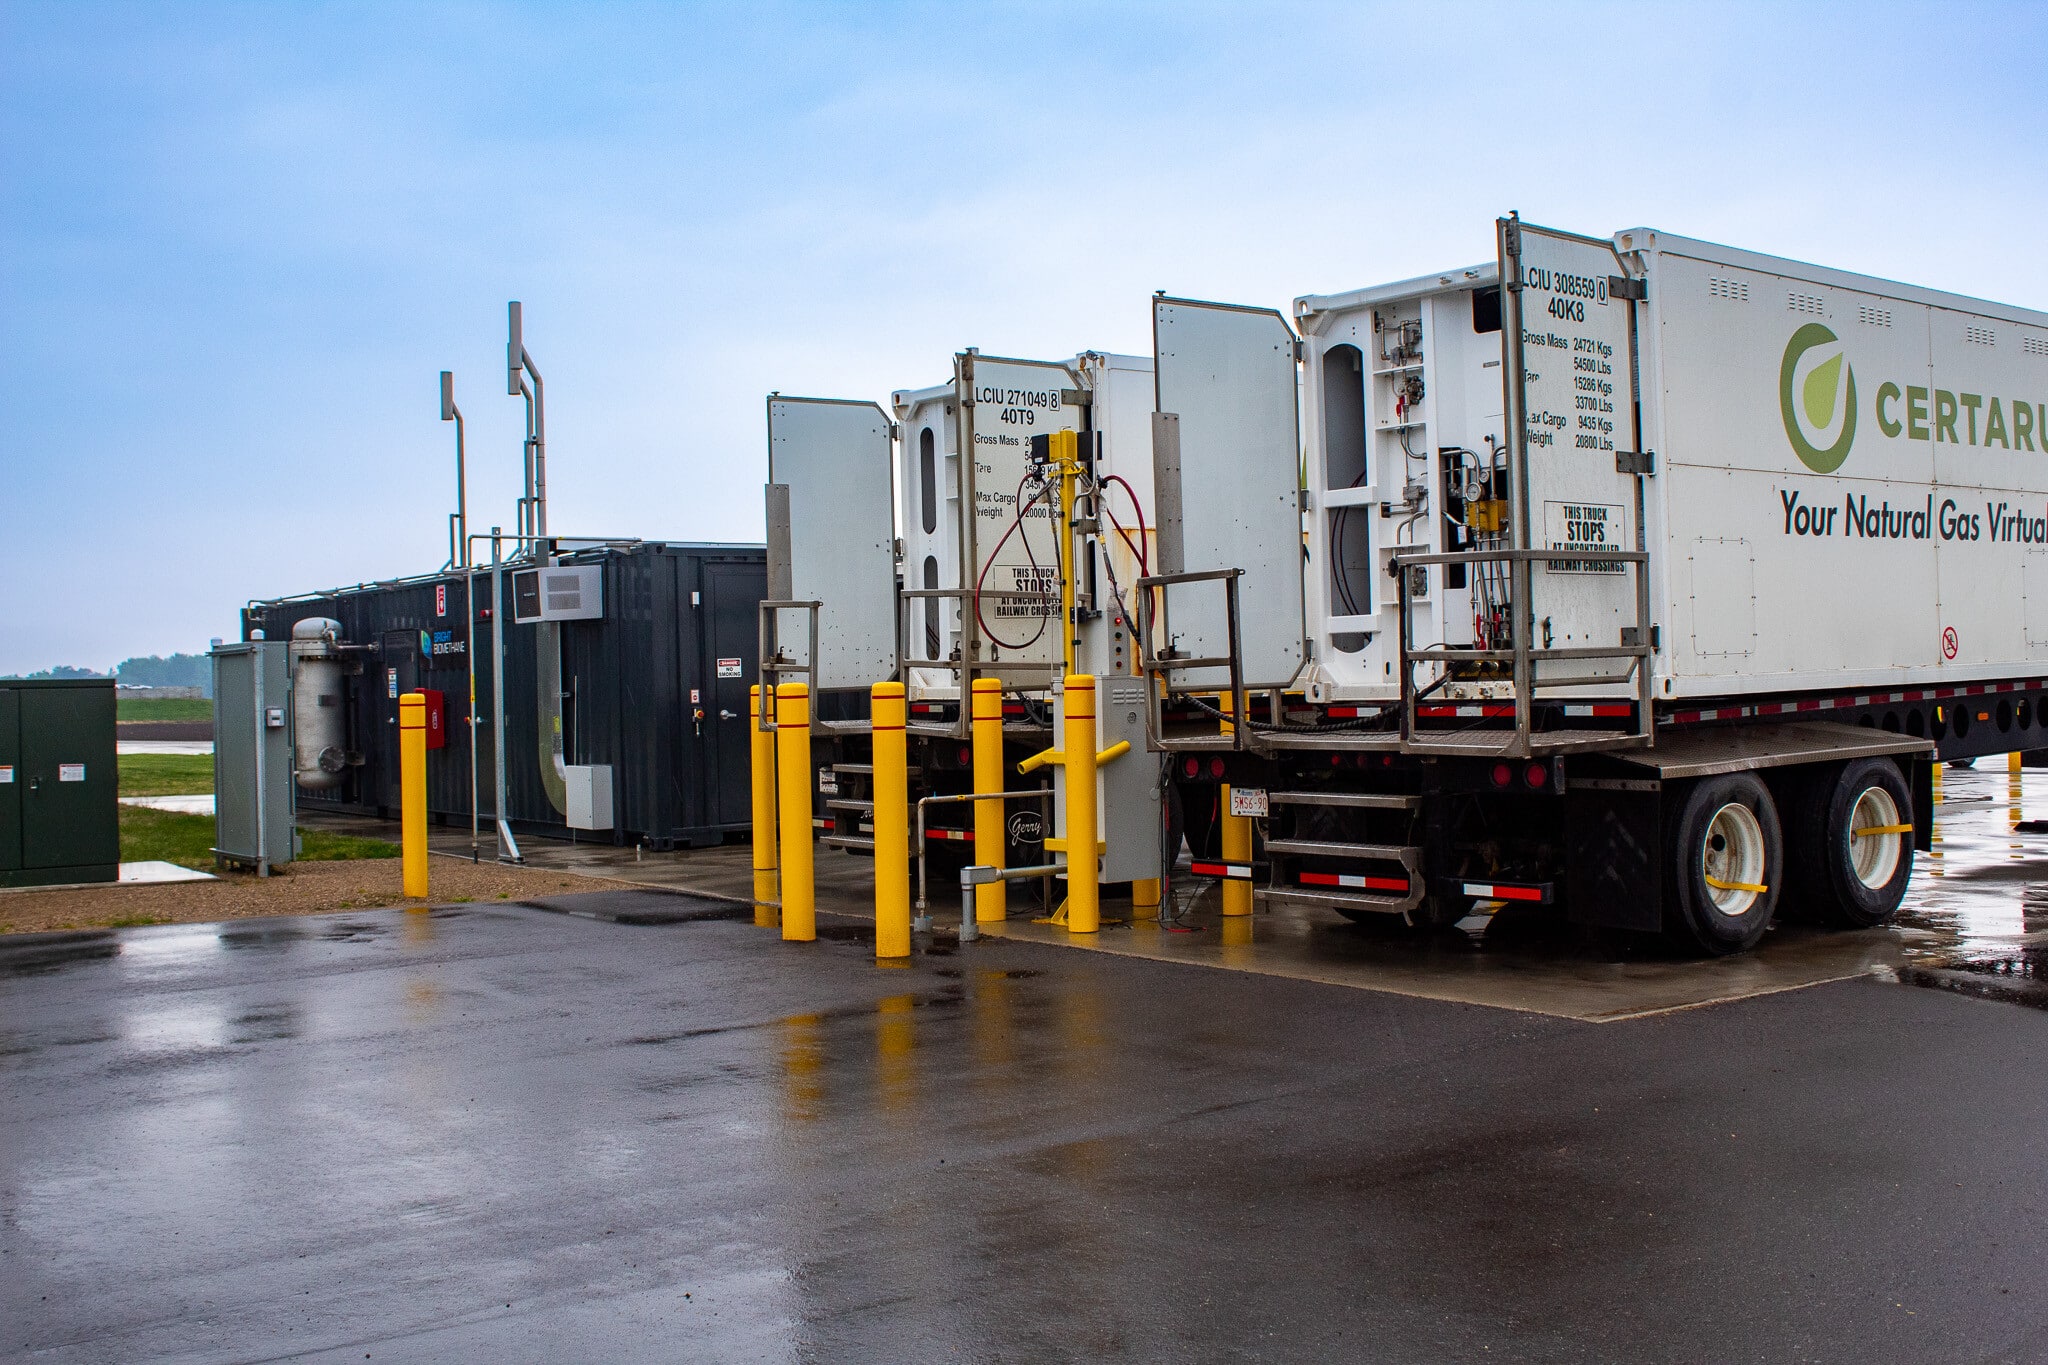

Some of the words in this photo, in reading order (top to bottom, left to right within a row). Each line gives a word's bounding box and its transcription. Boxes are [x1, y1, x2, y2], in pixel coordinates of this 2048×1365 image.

[1521, 265, 1550, 291] LCIU
[1554, 272, 1595, 299] 308559
[1599, 281, 1606, 301] 0
[1548, 297, 1585, 322] 40K8
[1522, 329, 1545, 346] Gross
[1547, 332, 1568, 349] Mass
[1573, 337, 1595, 353] 24721
[1597, 340, 1612, 357] Kgs
[1573, 356, 1595, 373] 54500
[1597, 360, 1612, 375] Lbs
[1574, 376, 1596, 391] 15286
[1597, 379, 1613, 395] Kgs
[975, 387, 1004, 404] LCIU
[1007, 390, 1047, 407] 271049
[1050, 393, 1058, 408] 8
[1575, 395, 1597, 411] 33700
[1599, 398, 1613, 414] Lbs
[1001, 408, 1035, 425] 40T9
[1542, 411, 1567, 429] Cargo
[1578, 415, 1597, 430] 9435
[1598, 418, 1613, 434] Kgs
[974, 433, 998, 445] Gross
[999, 435, 1019, 447] Mass
[1575, 434, 1597, 450] 20800
[1599, 436, 1613, 451] Lbs
[975, 462, 992, 473] Tare
[1024, 464, 1046, 476] 1569
[976, 492, 992, 502] Max
[992, 492, 1016, 505] Cargo
[976, 506, 1003, 519] Weight
[1563, 506, 1581, 520] THIS
[1583, 507, 1608, 521] TRUCK
[1780, 489, 1838, 536] Your
[1845, 493, 1932, 539] Natural
[1938, 498, 1979, 541] Gas
[1567, 521, 1605, 542] STOPS
[1012, 568, 1029, 578] THIS
[997, 606, 1029, 617] RAILWAY
